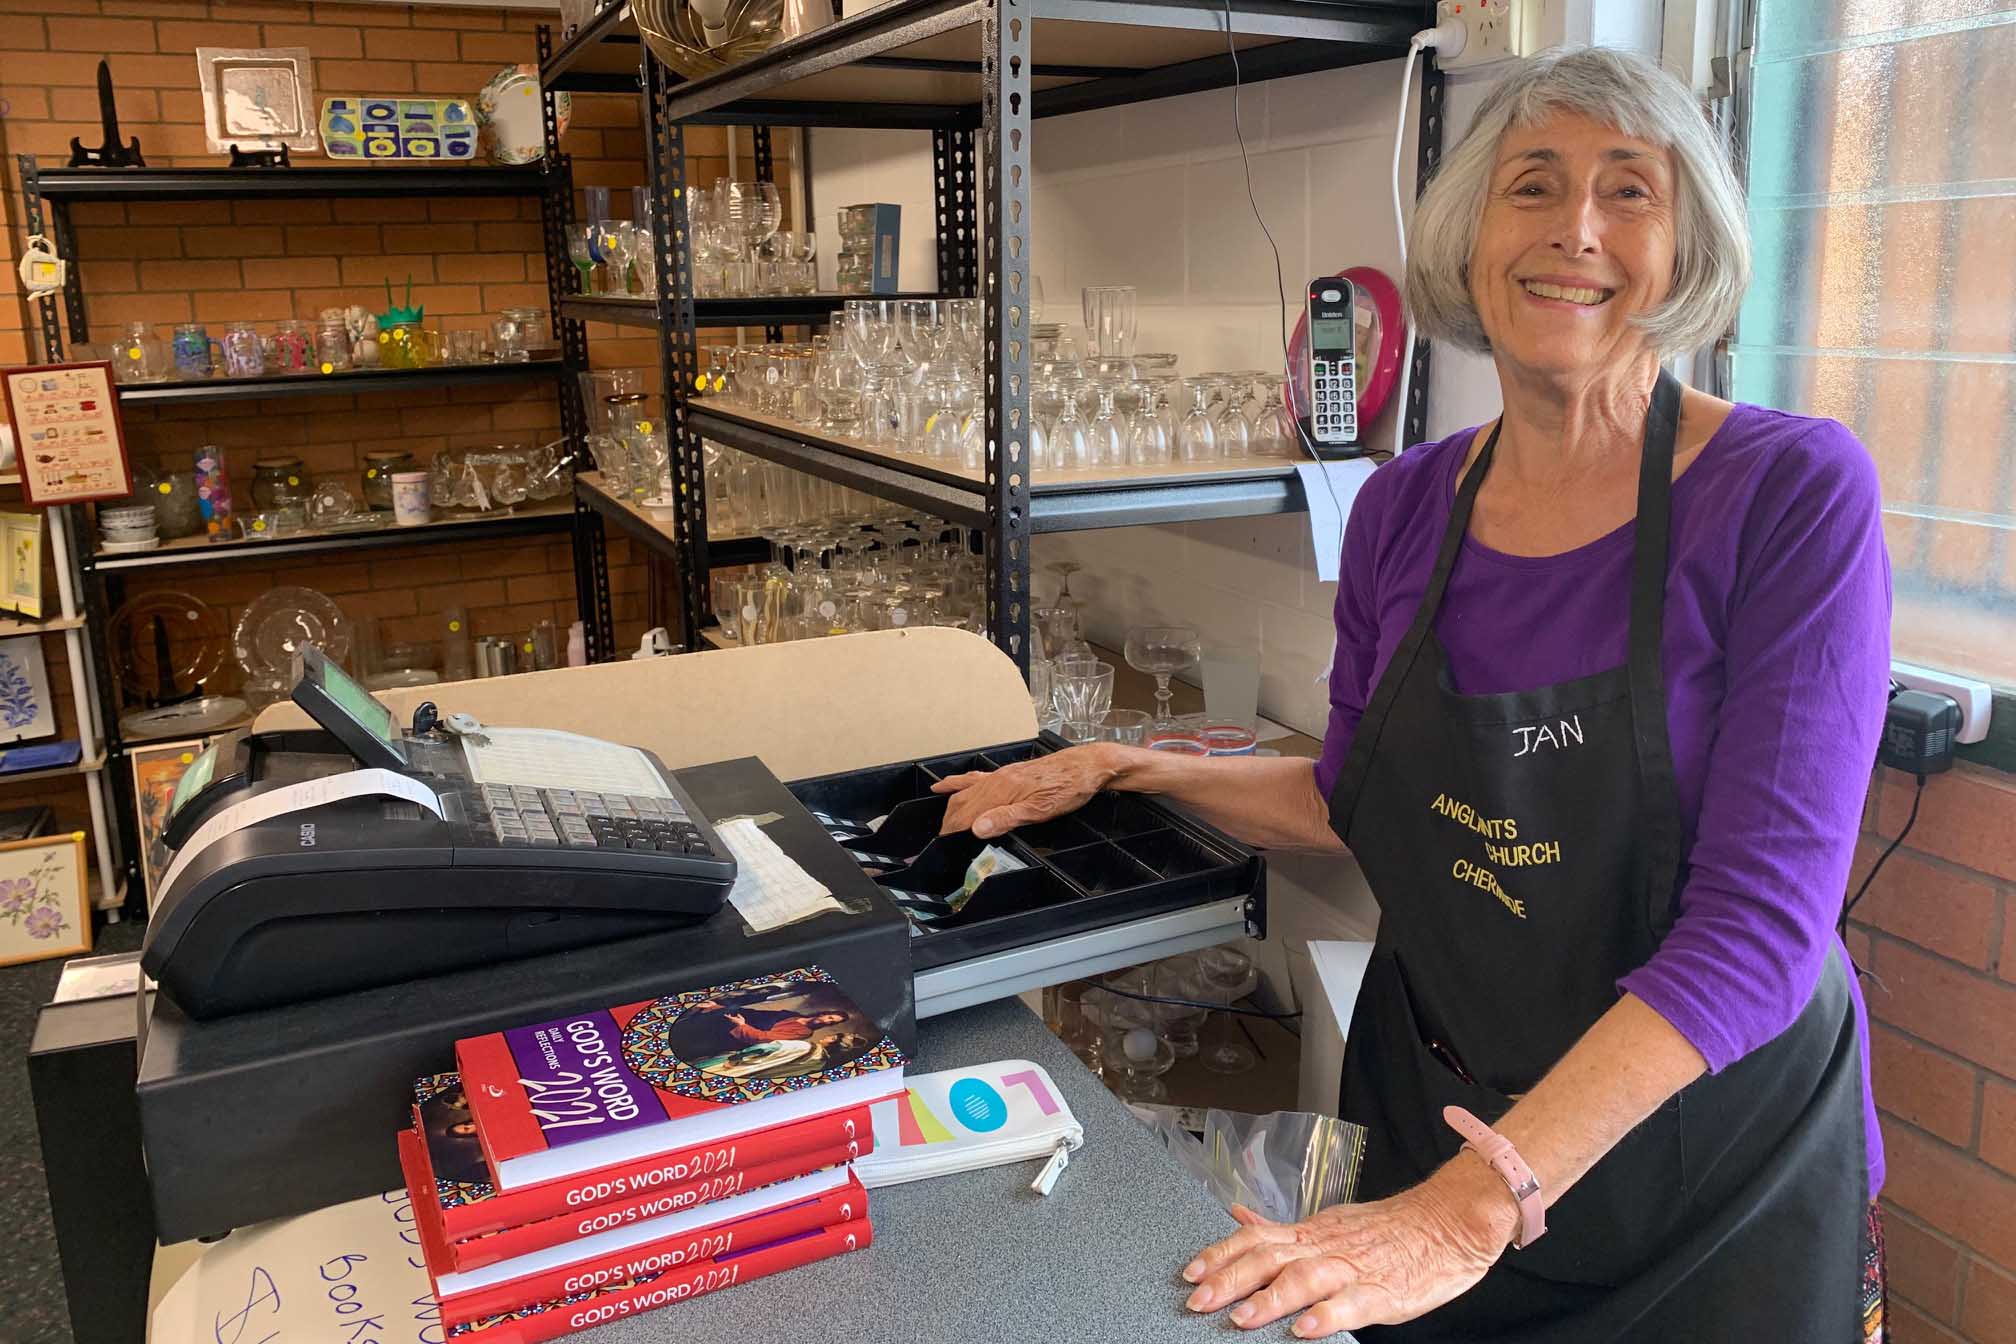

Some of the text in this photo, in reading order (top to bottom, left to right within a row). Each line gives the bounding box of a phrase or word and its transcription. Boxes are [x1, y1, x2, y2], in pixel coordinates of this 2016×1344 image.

[1512, 715, 1584, 757] JAN
[300, 823, 315, 847] CASIO
[1485, 841, 1561, 867] CHURCH
[534, 1030, 561, 1070] REFLECTIONS
[548, 1027, 565, 1043] DAILY
[566, 1020, 640, 1121] GOD'S WORD
[517, 1071, 606, 1130] 2021
[566, 1146, 737, 1206] GOD'S WORD 2021
[578, 1171, 744, 1234] GOD'S WORD 2021
[564, 1231, 733, 1293] GOD'S WORD 2021
[570, 1264, 739, 1328] GOD'S WORD 2021
